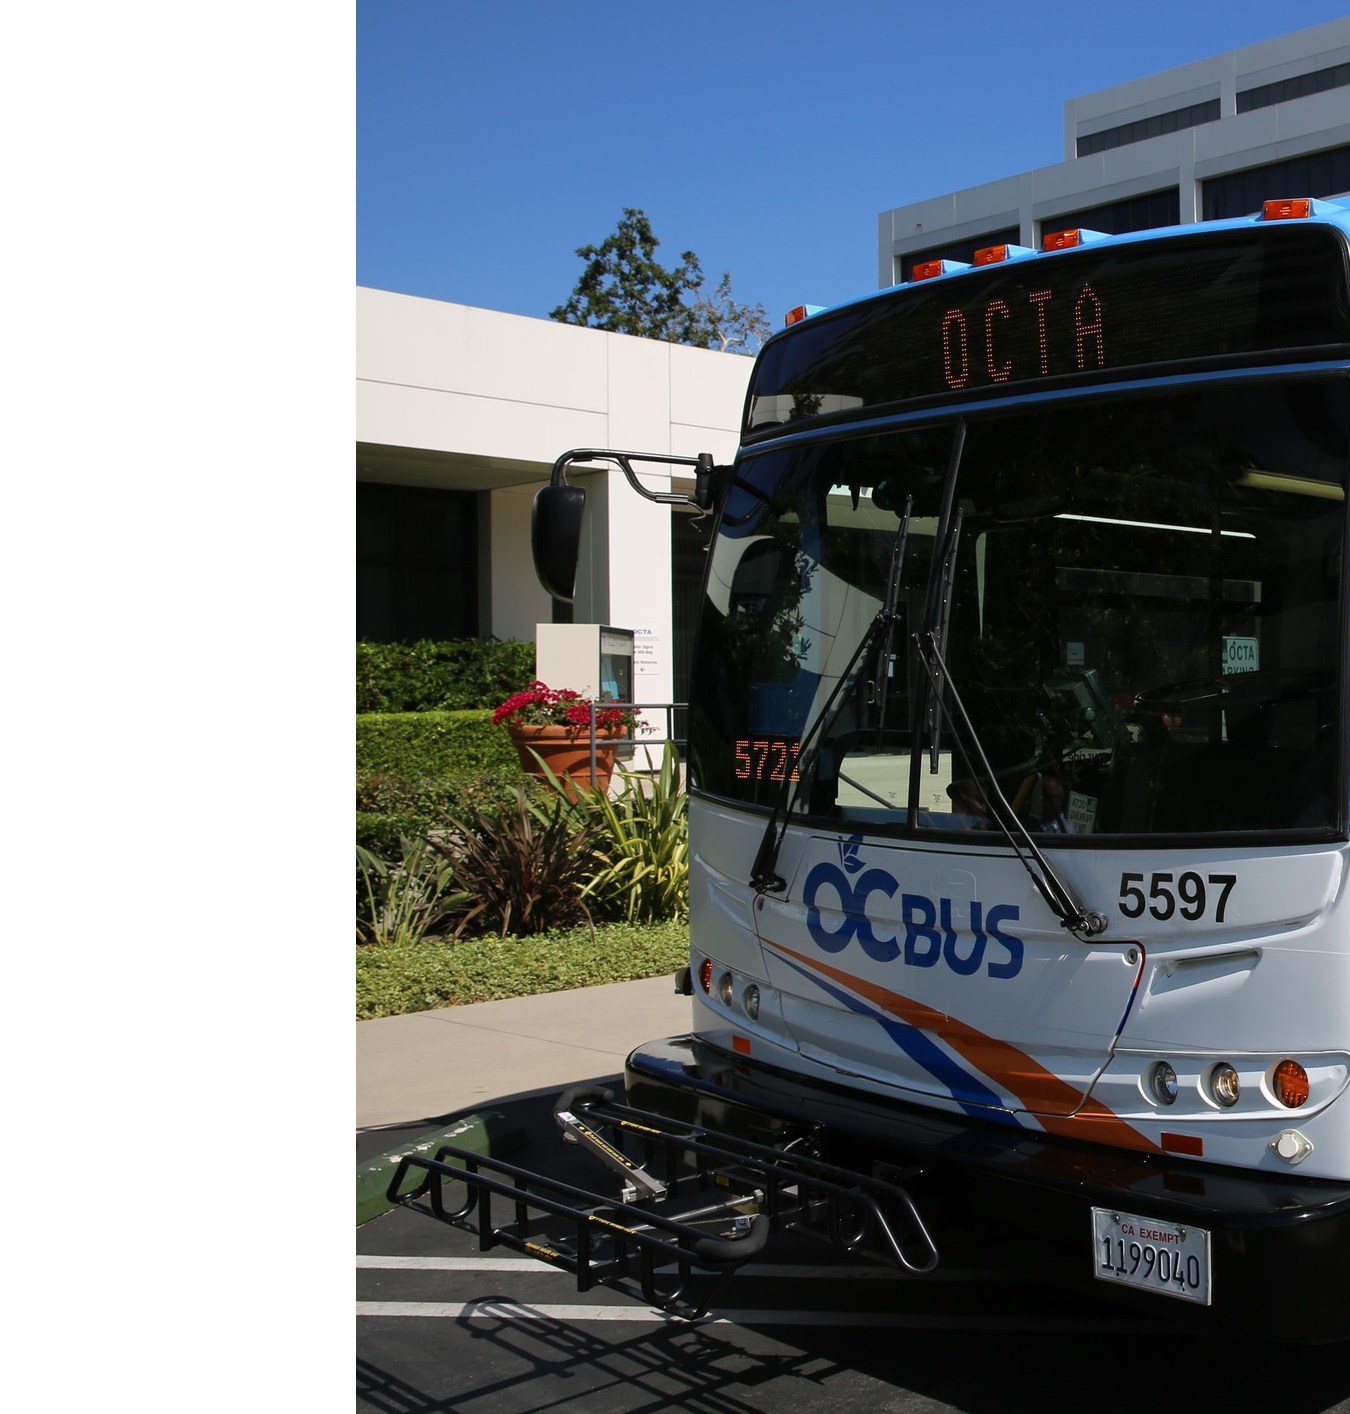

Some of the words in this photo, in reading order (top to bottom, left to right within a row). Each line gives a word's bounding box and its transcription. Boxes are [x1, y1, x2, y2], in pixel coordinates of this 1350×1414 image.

[943, 281, 1104, 389] OCTA
[1229, 645, 1254, 660] OCTA
[1118, 871, 1237, 923] 5597
[1122, 1224, 1135, 1236] CA
[1140, 1228, 1180, 1244] EXEMPT
[1101, 1236, 1200, 1289] 1199040
